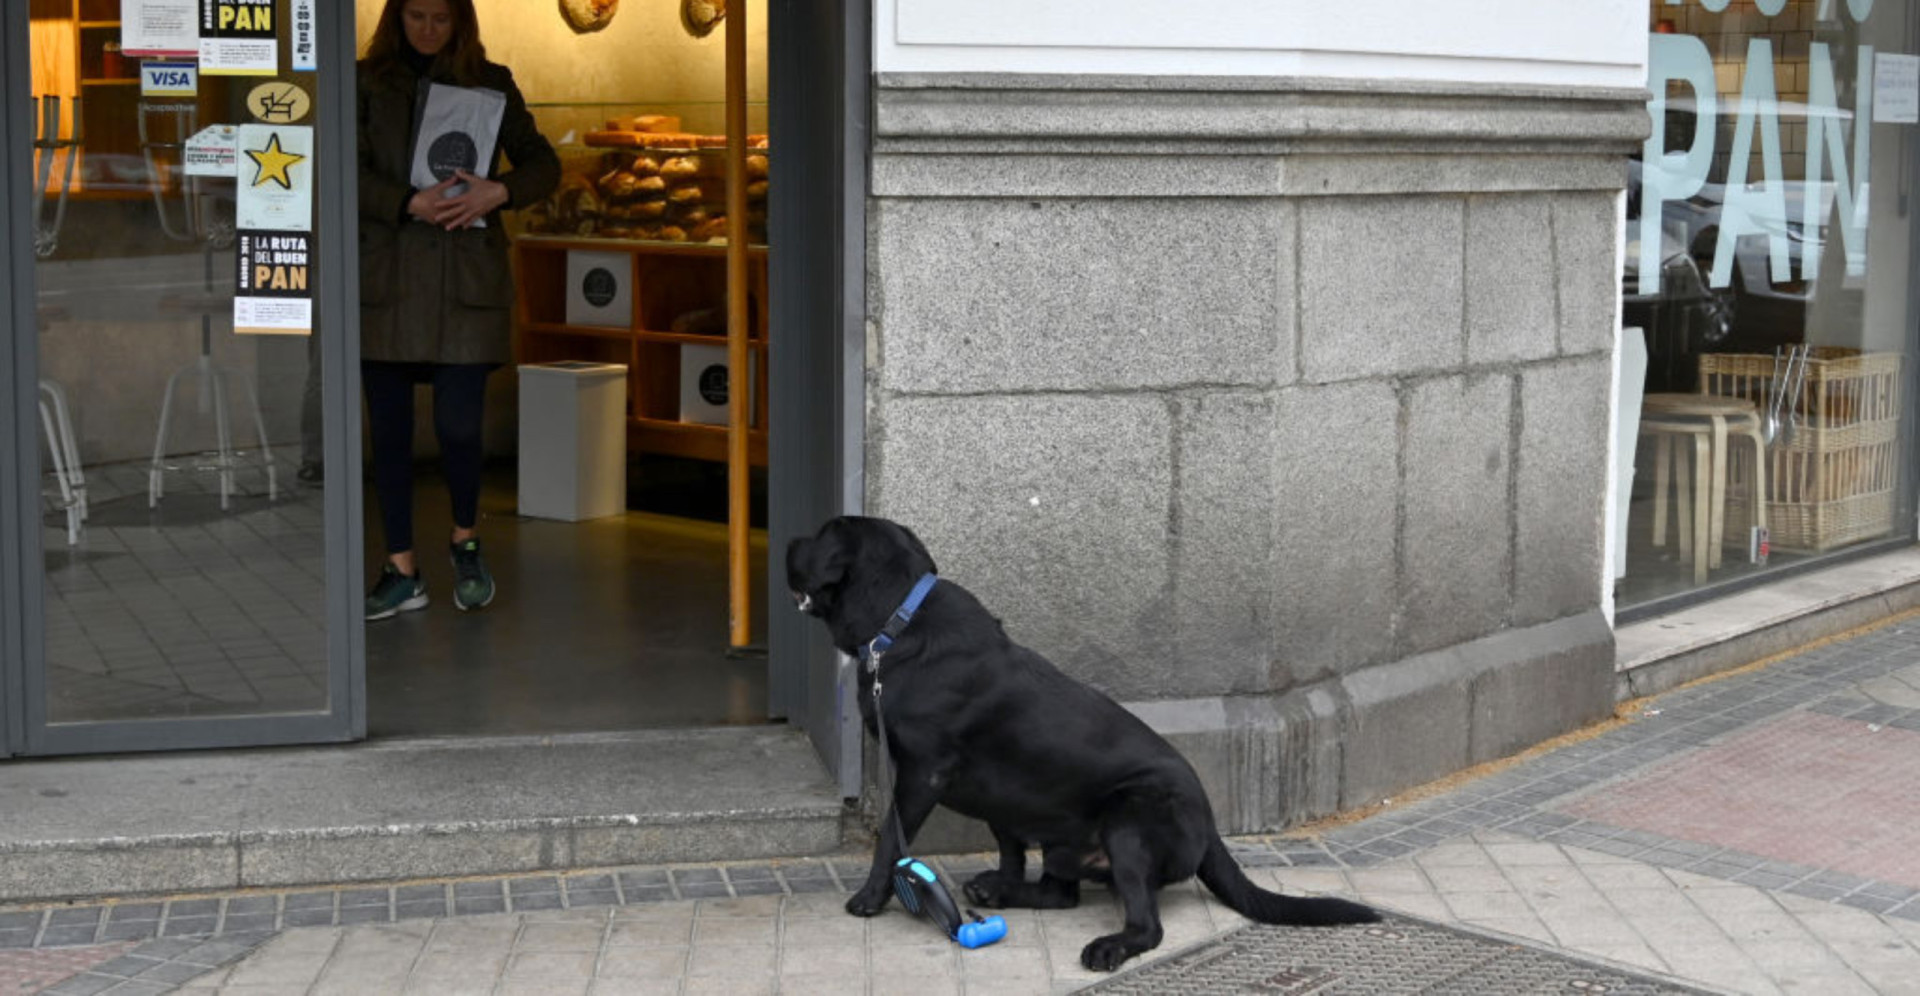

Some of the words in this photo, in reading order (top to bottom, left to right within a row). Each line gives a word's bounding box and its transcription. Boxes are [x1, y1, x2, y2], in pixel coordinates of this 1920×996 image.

[219, 5, 271, 31] PAN
[150, 71, 191, 86] VISA
[1637, 32, 1875, 296] PAN
[255, 236, 269, 250] LA
[271, 237, 307, 250] RUTA
[254, 251, 272, 264] DEL
[274, 252, 307, 265] BUEN
[255, 266, 306, 290] PAN
